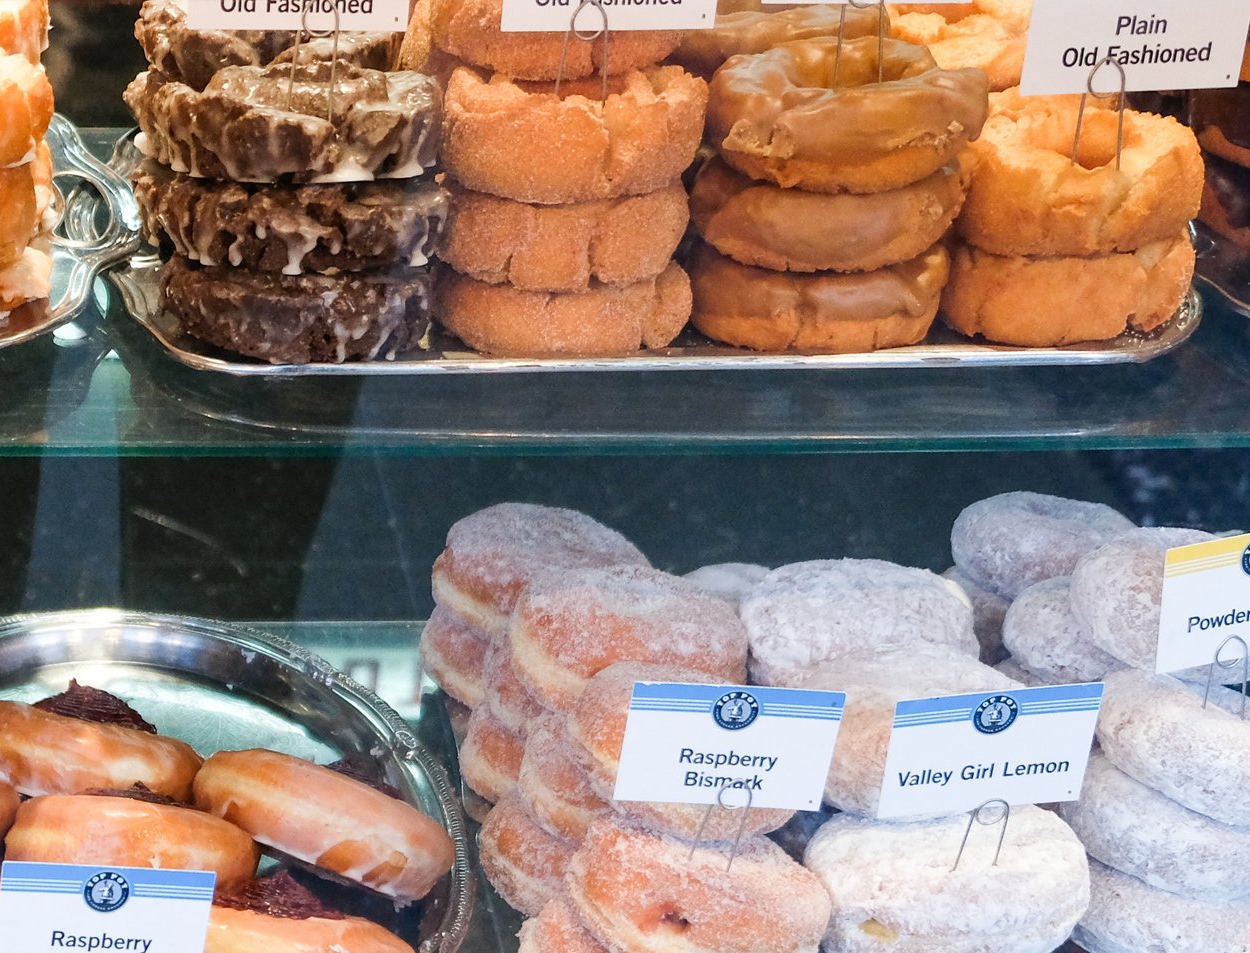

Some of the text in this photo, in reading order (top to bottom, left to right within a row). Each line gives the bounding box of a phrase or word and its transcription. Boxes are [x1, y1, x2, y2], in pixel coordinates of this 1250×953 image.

[1115, 14, 1168, 36] Plain
[1062, 41, 1212, 67] Old Fashioned
[679, 748, 778, 772] Raspberry
[684, 771, 763, 790] Bismark
[898, 760, 1070, 787] Valley Girl Lemon
[50, 930, 152, 953] Raspberry
